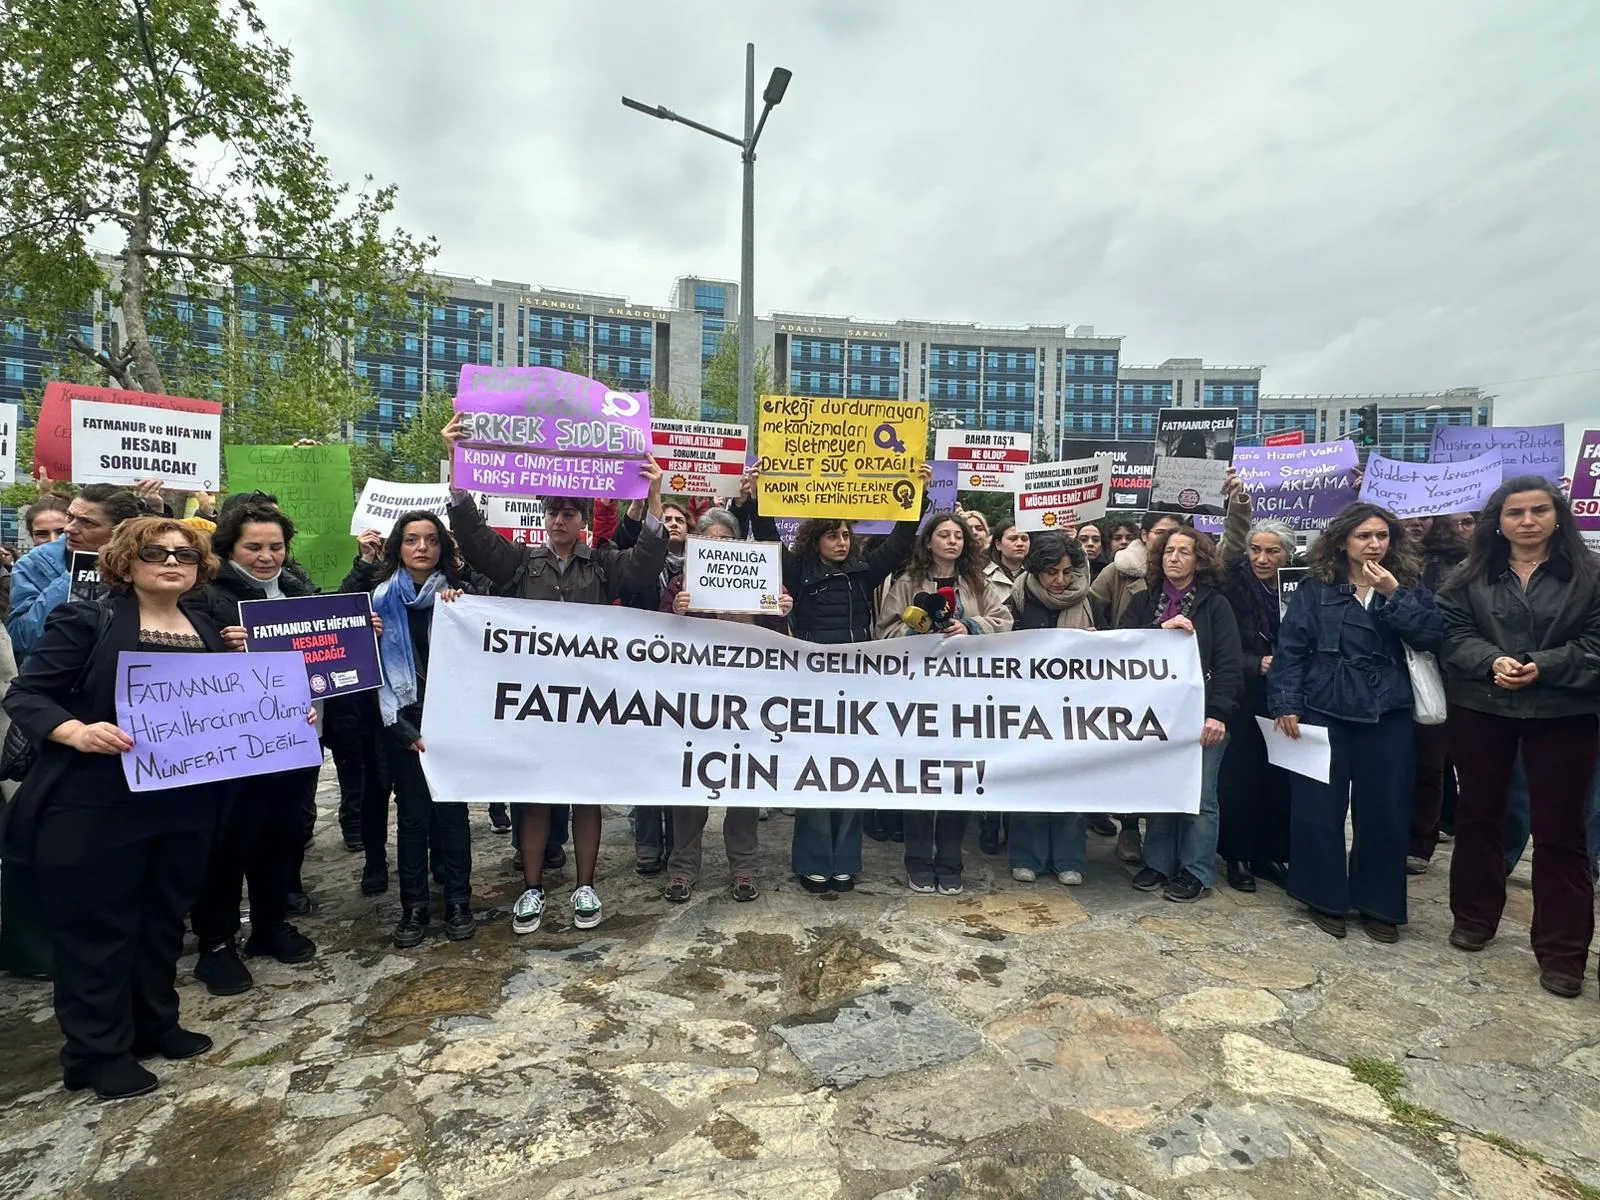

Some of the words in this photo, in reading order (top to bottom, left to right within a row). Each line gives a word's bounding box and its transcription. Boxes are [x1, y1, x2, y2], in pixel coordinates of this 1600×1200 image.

[520, 296, 582, 311] İSTANBUL
[608, 308, 666, 320] ANADOLU
[780, 324, 823, 334] ADALET
[848, 329, 888, 338] SARAYI
[763, 397, 815, 423] erkeği
[821, 400, 926, 423] durdurmayan,
[83, 417, 146, 433] FATMANUR
[149, 425, 163, 435] ve
[166, 425, 212, 440] HİFA'NIN
[460, 412, 546, 445] ERKEK
[651, 422, 683, 432] FATMANUR
[685, 424, 692, 433] VE
[716, 427, 742, 437] OLANLAR
[763, 420, 868, 438] mekanizmaları
[1161, 420, 1211, 431] FATMANUR
[1211, 417, 1234, 432] ÇELİK
[121, 437, 177, 455] HESABI
[669, 434, 724, 448] AYDINLATILSIN!
[784, 436, 866, 458] işletmeyen
[965, 434, 991, 446] BAHAR
[993, 436, 1015, 449] TAŞ'A
[464, 450, 506, 467] KADIN
[515, 453, 625, 476] CİNAYETLERİNE
[673, 449, 716, 461] SORUMLULAR
[972, 450, 982, 459] NE
[982, 450, 1007, 460] OLDU?
[100, 454, 197, 476] SORULACAK!
[669, 461, 693, 471] HESAP
[694, 462, 721, 474] VERSİN!
[761, 456, 815, 471] DEVLET
[821, 458, 848, 475] SUÇ
[1024, 468, 1072, 481] İSTİSMARCILARI
[1074, 464, 1099, 476] KORUYAN
[473, 468, 515, 488] KARŞI
[520, 472, 615, 491] FEMİNİSTLER
[764, 482, 799, 493] KADIN
[806, 480, 893, 493] CİNAYETLERİNE
[1025, 482, 1032, 491] BU
[1033, 480, 1061, 490] KARANLIK
[1062, 476, 1084, 487] DÜZENE
[1279, 475, 1349, 492] AKLAMA
[370, 492, 442, 507] ÇOCUKLARIN
[782, 494, 810, 506] KARŞI
[814, 493, 888, 505] FEMİNİSTLER
[1025, 490, 1082, 508] MÜCADELEMİZ
[1082, 488, 1098, 501] VAR!
[698, 548, 767, 564] KARANLIĞA
[706, 563, 759, 577] MEYDAN
[699, 576, 767, 590] OKUYORUZ
[252, 620, 312, 640] FATMANUR
[312, 618, 325, 632] VE
[326, 614, 367, 631] HİFA'NIN
[292, 633, 339, 650] HESABINI
[483, 622, 619, 660] İSTİSMAR
[626, 635, 800, 671] GÖRMEZDEN
[806, 649, 916, 681] GELİNDİ,
[924, 651, 1024, 680] FAİLLER
[1029, 658, 1179, 681] KORUNDU.
[128, 664, 245, 709] FATMANUR
[252, 666, 286, 690] VE
[494, 682, 750, 731] FATMANUR
[760, 690, 880, 743] ÇELİK
[886, 701, 939, 738] VE
[952, 694, 1053, 741] HİFA
[1063, 696, 1169, 742] İKRA
[135, 746, 238, 786] MÜNFERİT
[238, 732, 308, 760] DEĞİL
[681, 740, 780, 800] İÇİN
[794, 755, 987, 797] ADALET!
